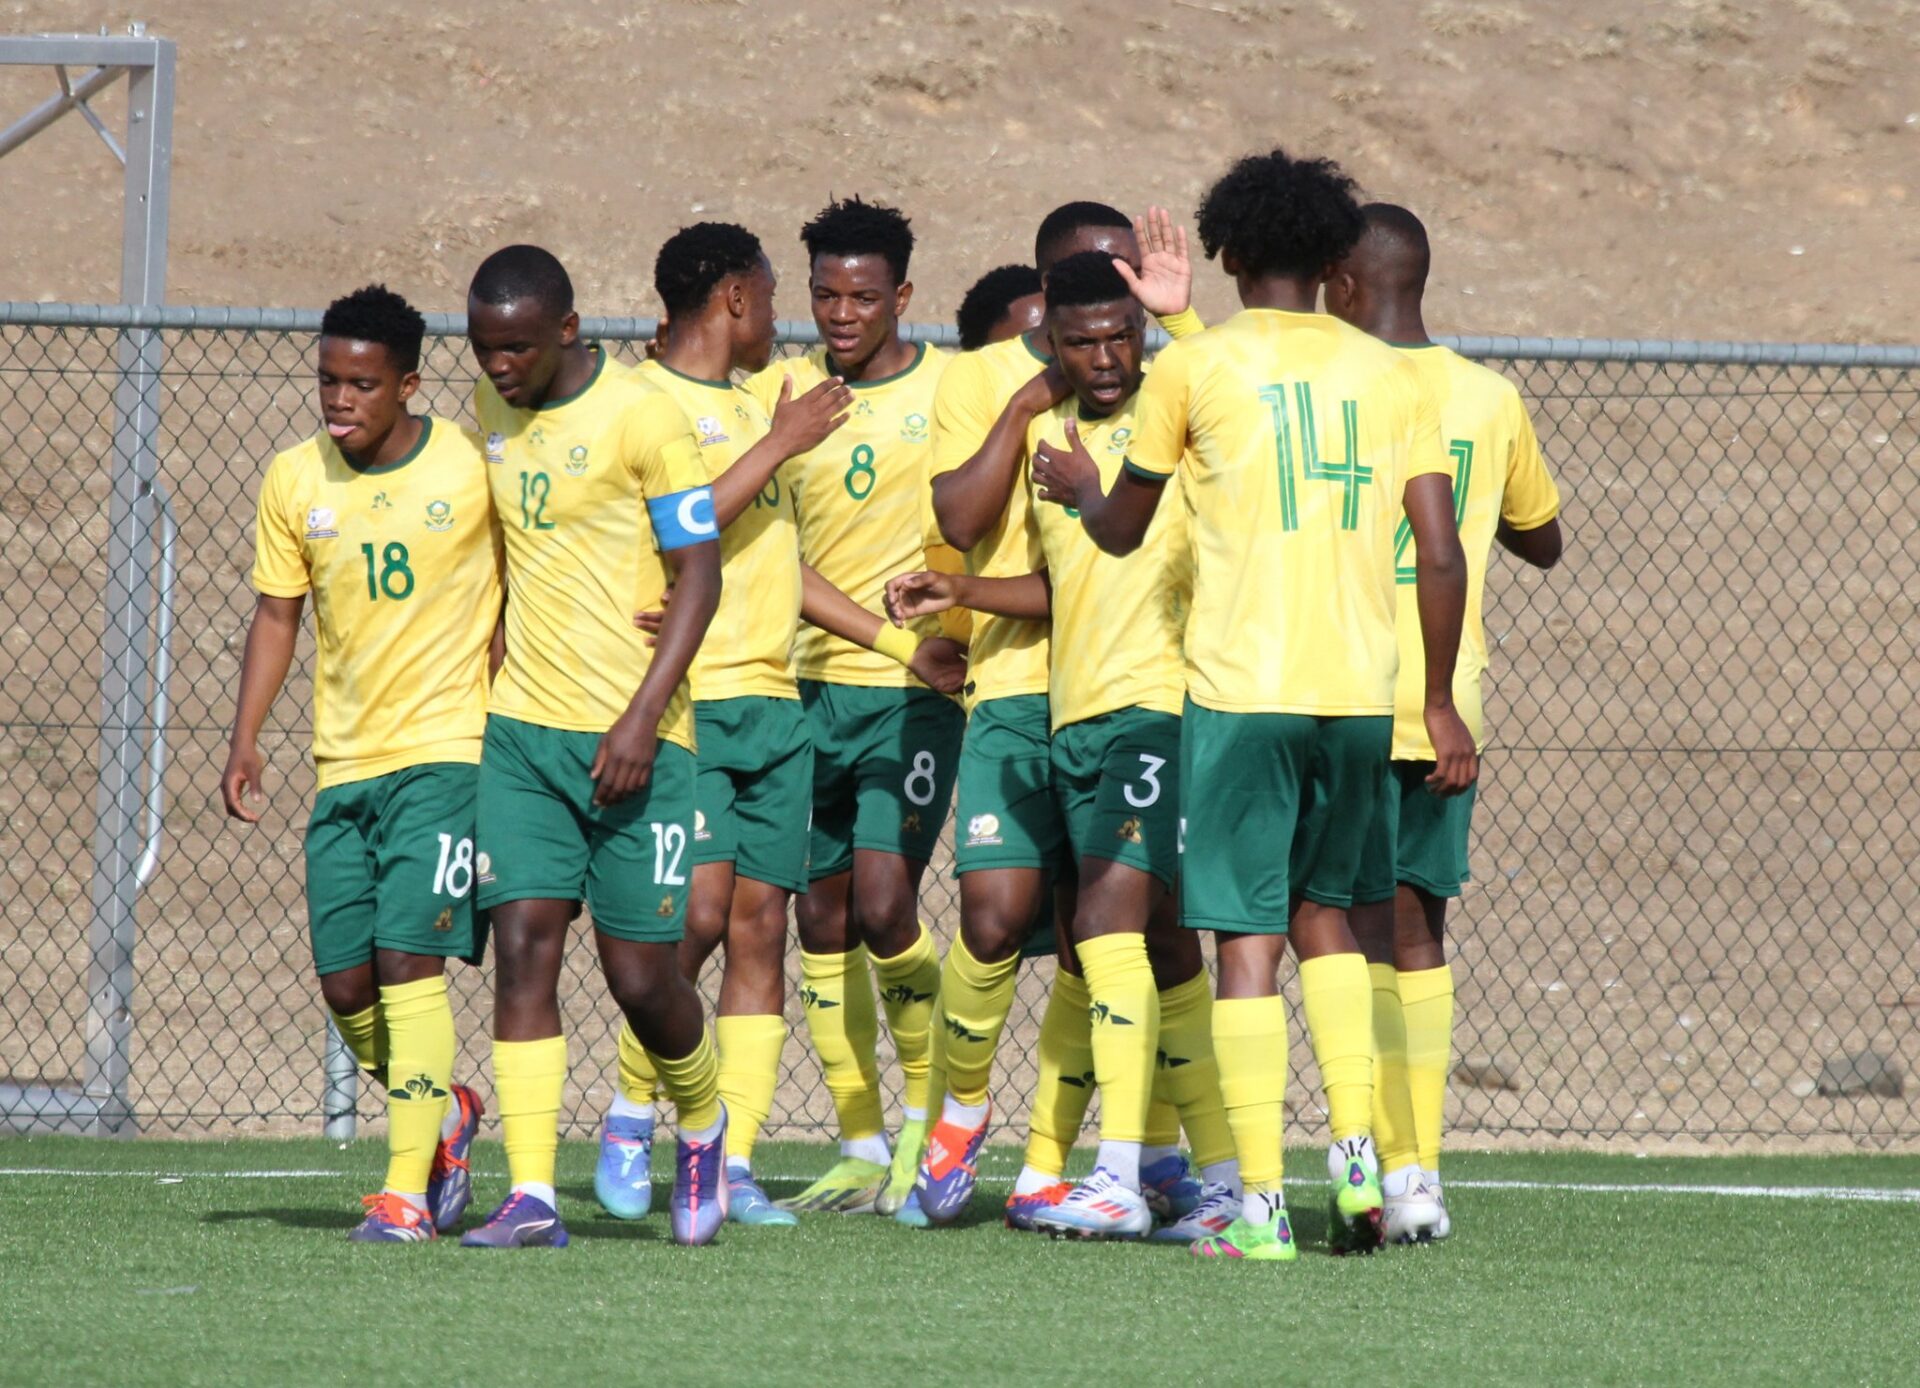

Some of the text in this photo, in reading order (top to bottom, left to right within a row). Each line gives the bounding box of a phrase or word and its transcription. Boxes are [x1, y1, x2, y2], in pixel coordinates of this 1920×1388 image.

[844, 443, 876, 501] 8
[1258, 381, 1373, 531] 14
[519, 470, 556, 531] 12
[677, 489, 717, 535] C
[360, 541, 416, 602] 18
[903, 750, 936, 806] 8
[1123, 753, 1167, 808] 3
[432, 832, 473, 898] 18
[650, 821, 687, 886] 12
